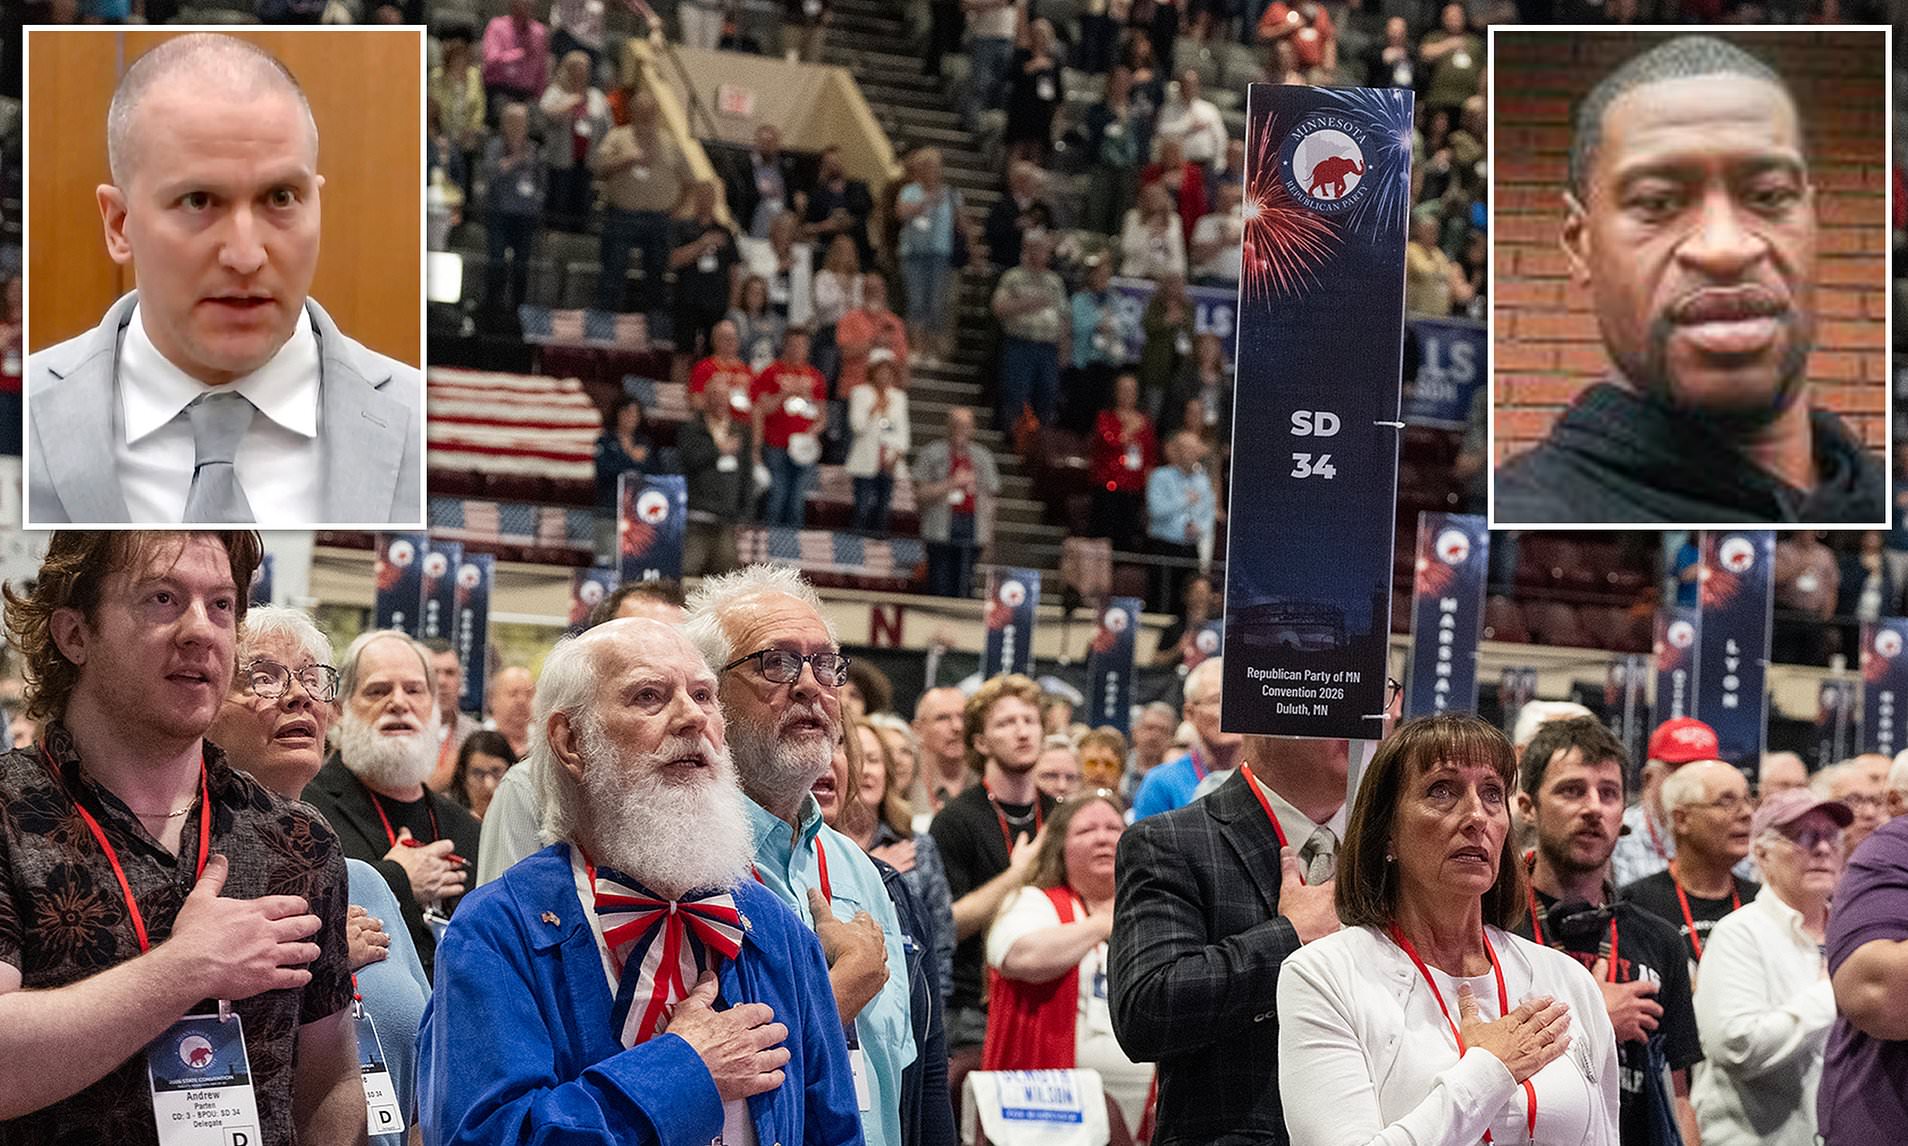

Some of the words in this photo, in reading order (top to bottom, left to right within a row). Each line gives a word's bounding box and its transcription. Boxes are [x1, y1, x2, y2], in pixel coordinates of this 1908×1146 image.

[1291, 117, 1367, 144] MINNESOTA
[1284, 180, 1341, 212] REPUBLICAN
[1341, 183, 1369, 208] PARTY
[1290, 410, 1341, 437] SD
[1290, 452, 1337, 480] 34
[1247, 666, 1302, 681] Republican
[1304, 669, 1331, 684] Party
[1333, 671, 1344, 682] of
[1345, 672, 1361, 683] MN
[1722, 639, 1740, 708] LYON
[1262, 685, 1317, 698] Convention
[1319, 687, 1344, 699] 2026
[1276, 703, 1311, 716] Duluth,
[1313, 704, 1328, 716] MN
[186, 1091, 220, 1101] Andrew
[232, 1108, 241, 1116] 34
[379, 1110, 392, 1124] D
[193, 1119, 223, 1128] Delegate
[232, 1132, 248, 1146] D
